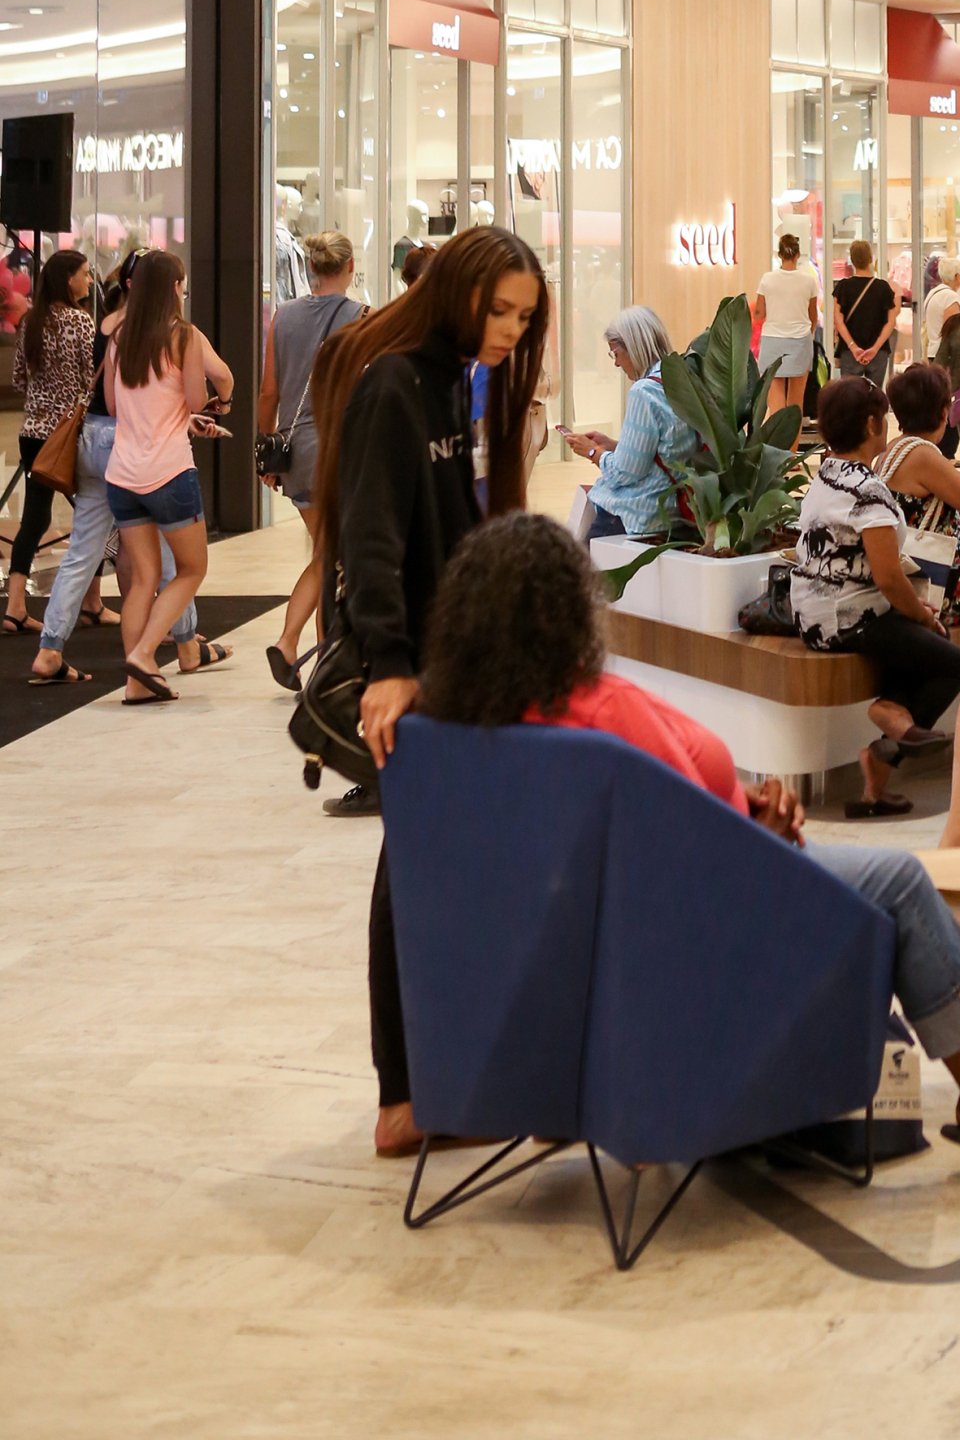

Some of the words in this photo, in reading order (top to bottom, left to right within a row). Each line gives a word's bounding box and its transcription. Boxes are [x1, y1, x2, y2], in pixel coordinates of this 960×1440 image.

[432, 15, 460, 50] seed
[929, 90, 957, 114] seed
[679, 201, 738, 266] seed
